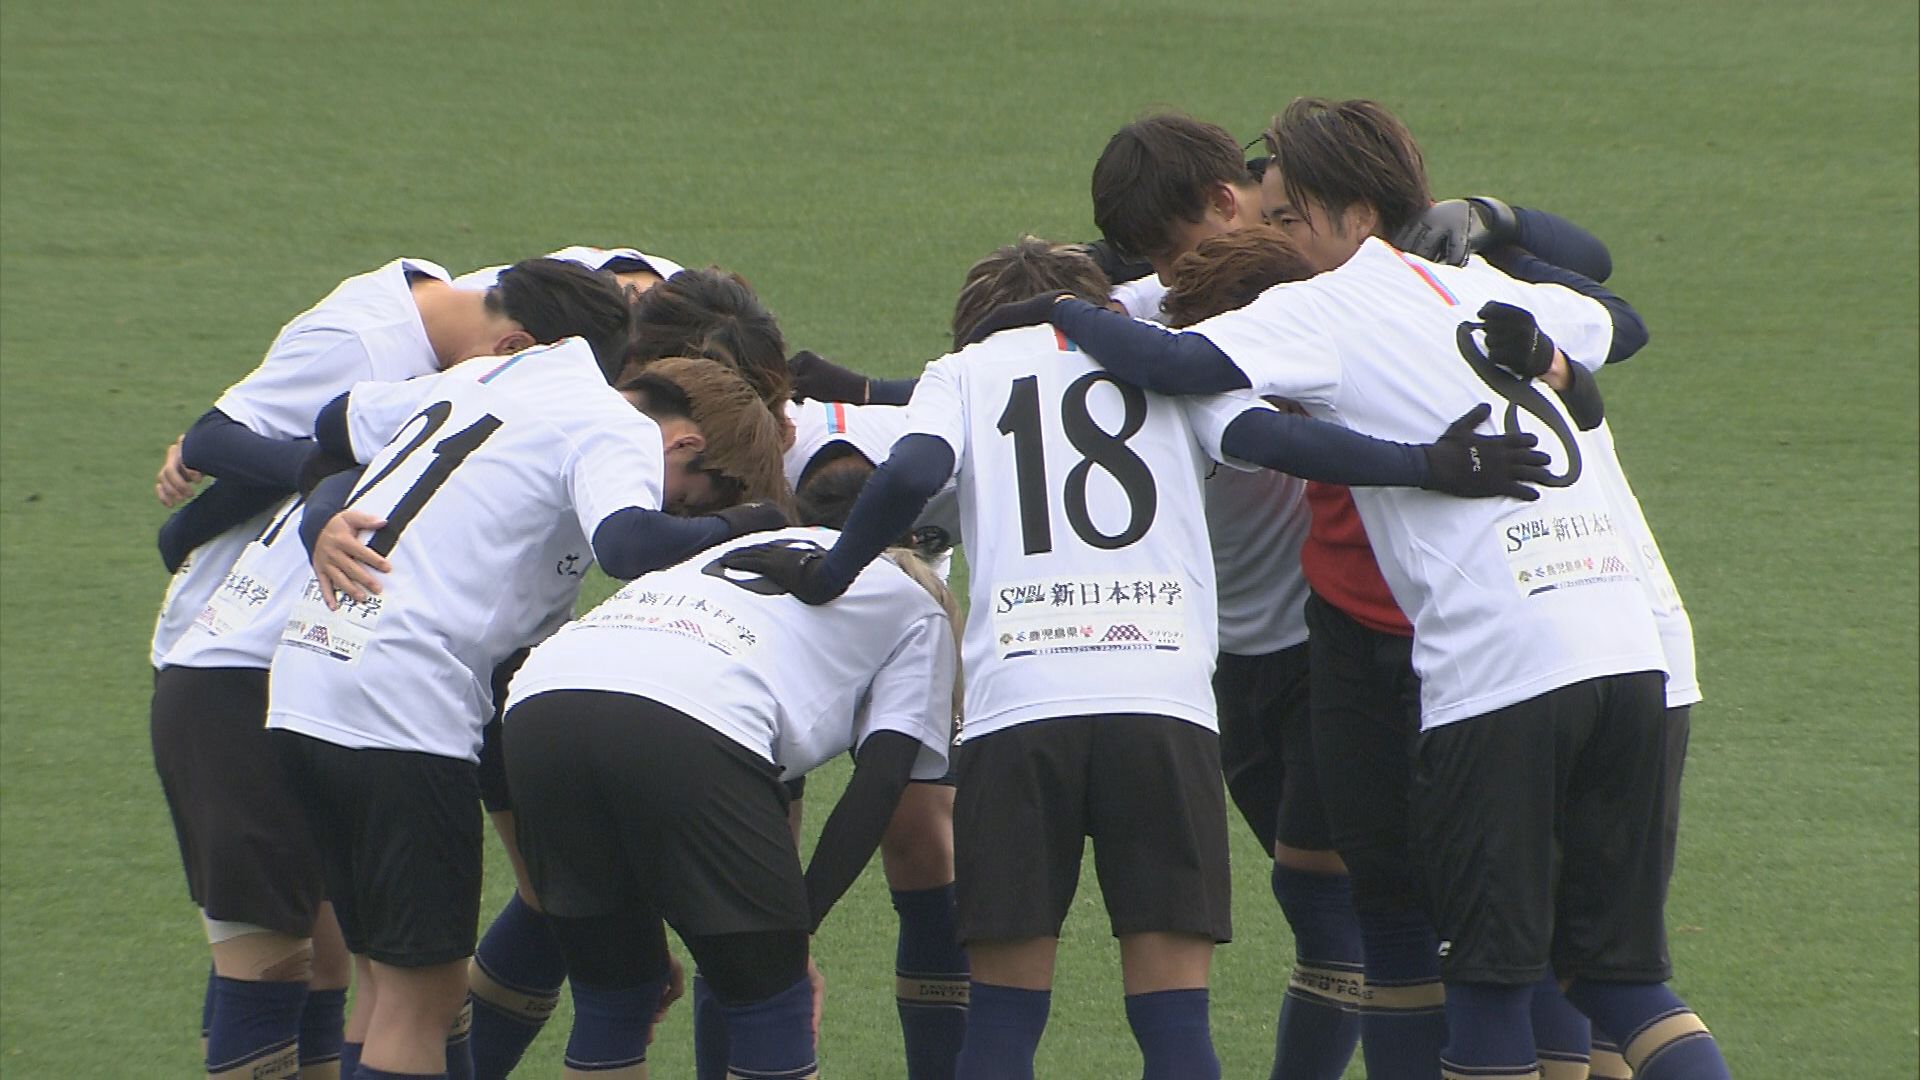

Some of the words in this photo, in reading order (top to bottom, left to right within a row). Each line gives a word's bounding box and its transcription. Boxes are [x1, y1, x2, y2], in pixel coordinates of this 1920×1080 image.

[1456, 320, 1582, 487] 8
[996, 371, 1157, 556] 18
[1506, 519, 1550, 553] SNBL
[996, 584, 1046, 614] SNBL
[1050, 580, 1183, 606] 新日本科学
